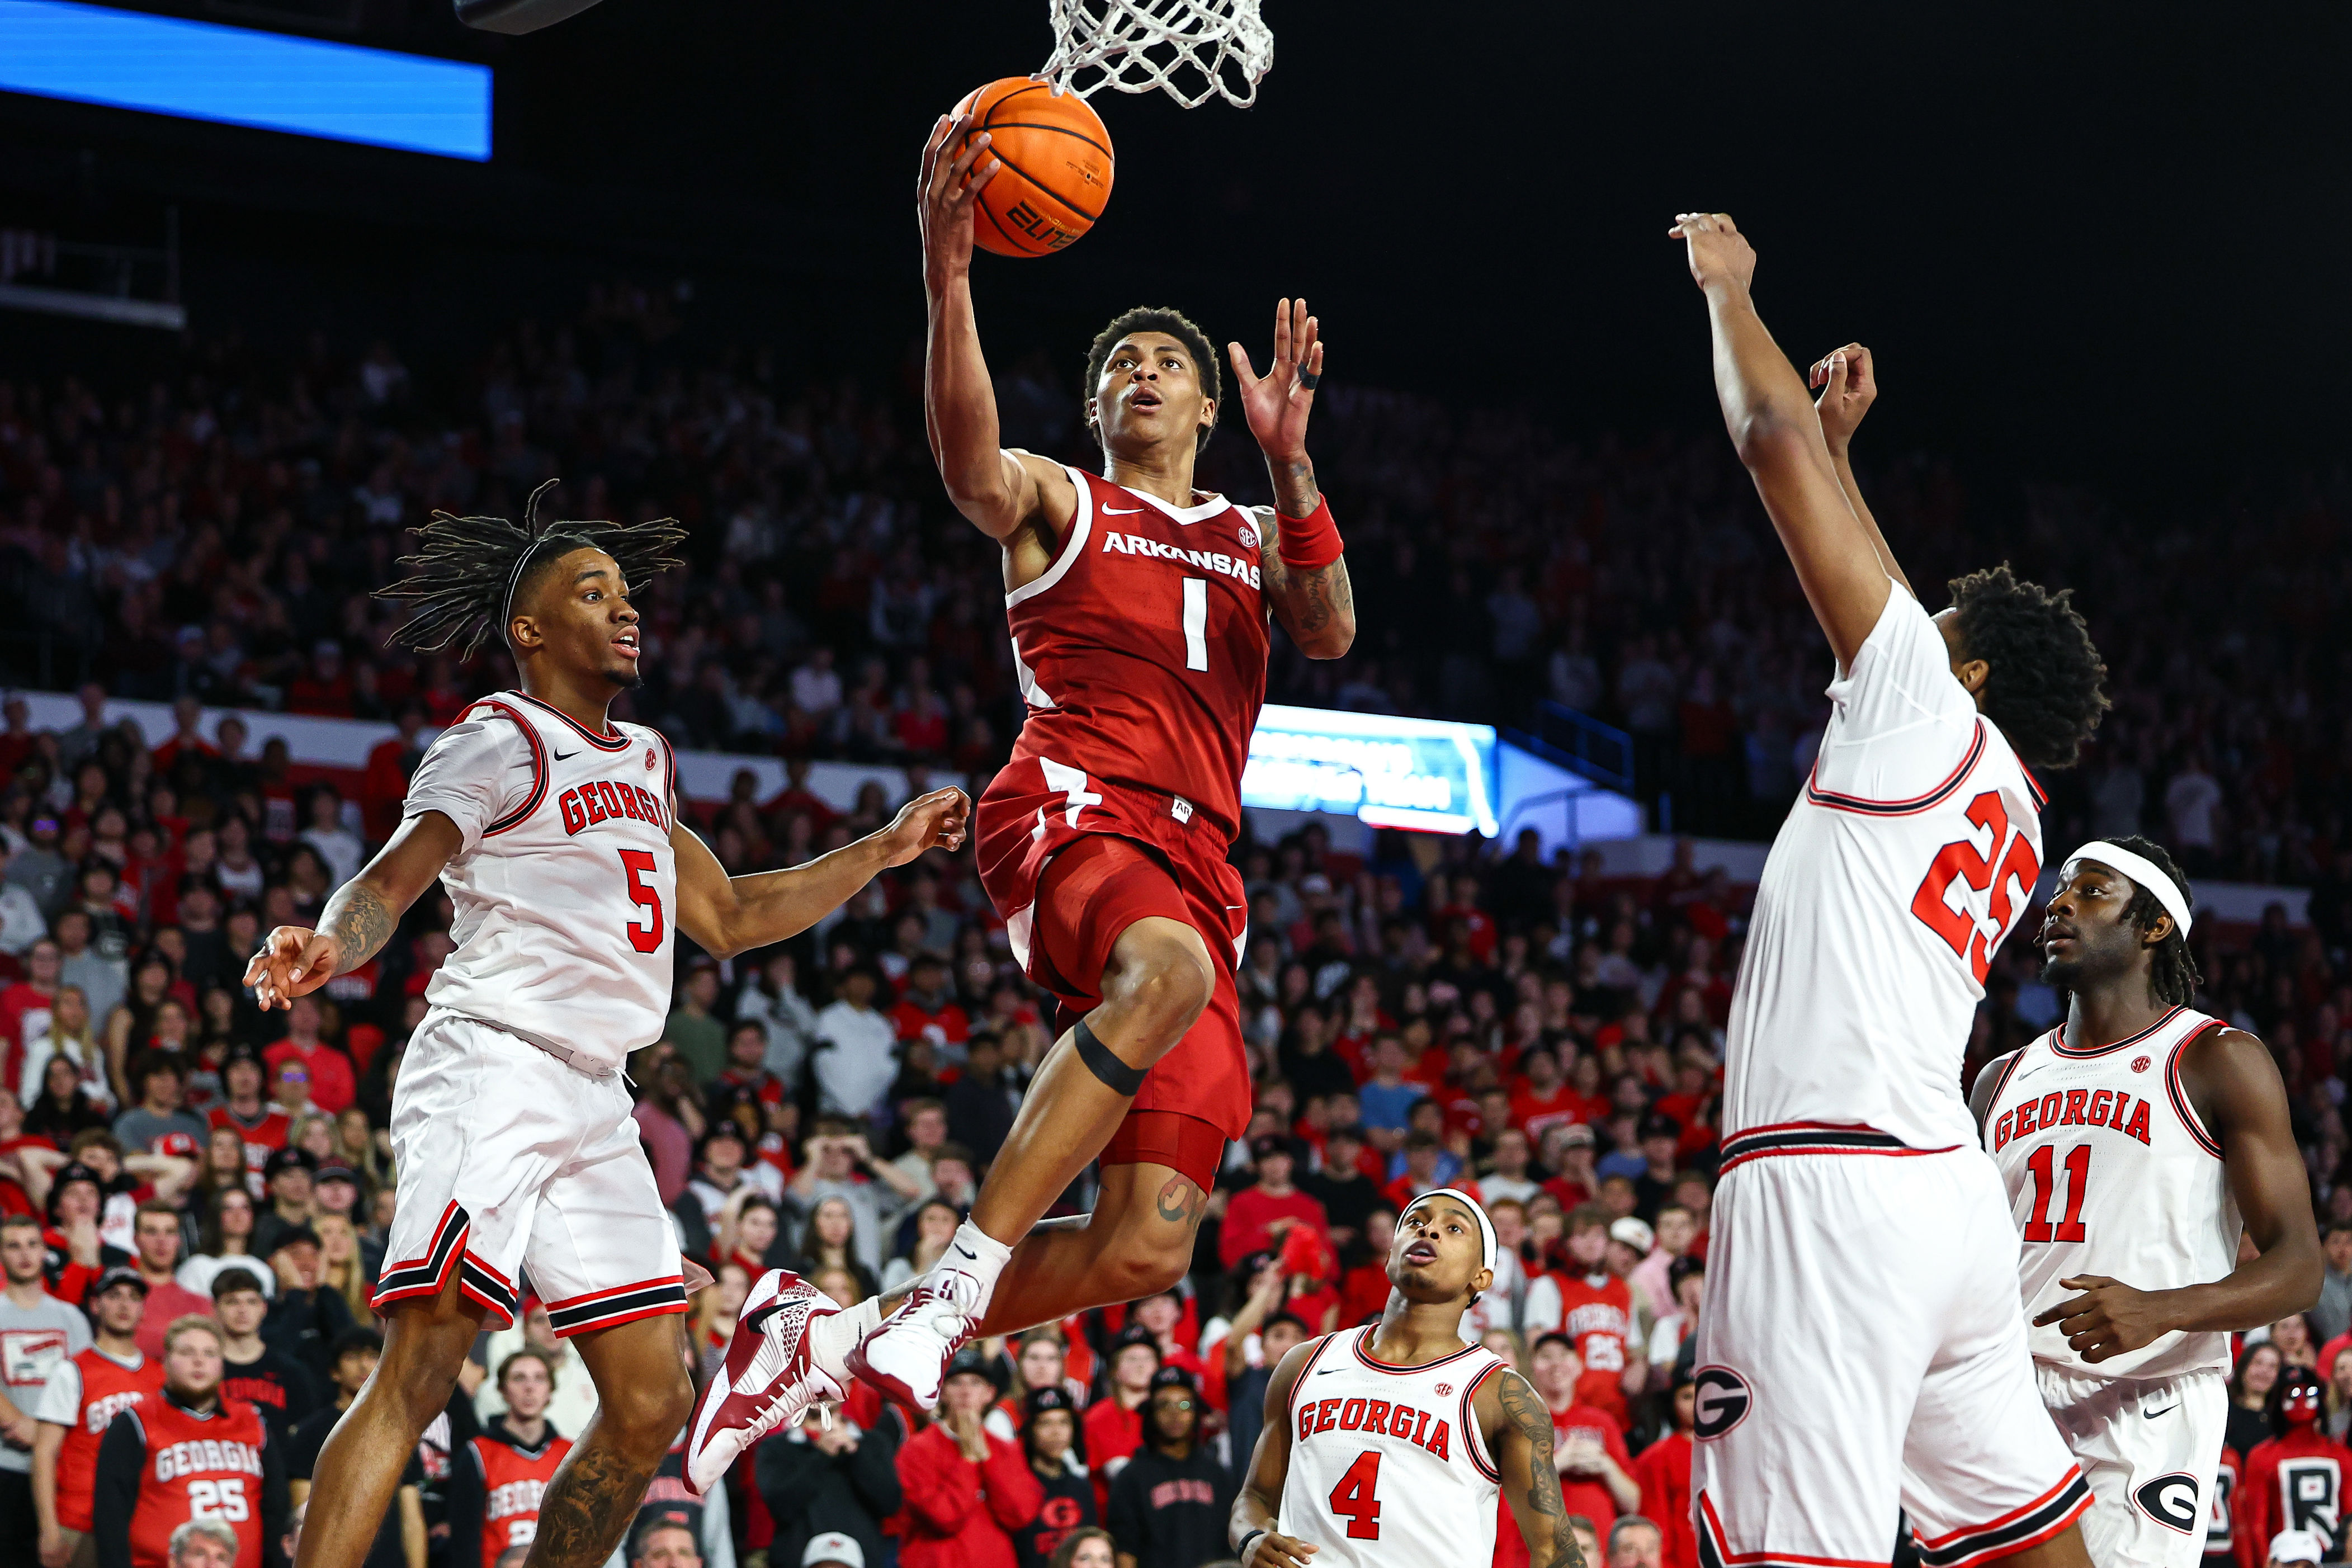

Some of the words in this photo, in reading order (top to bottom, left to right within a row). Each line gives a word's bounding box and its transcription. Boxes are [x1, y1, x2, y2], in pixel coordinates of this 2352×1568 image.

[1006, 200, 1077, 248] ELITE
[1102, 531, 1261, 591] ARKANSAS
[1240, 528, 1255, 546] SEC
[1183, 577, 1208, 672] 1
[1175, 802, 1189, 817] AR
[617, 848, 664, 954] 5
[1910, 789, 2041, 987] 25
[2132, 1057, 2150, 1071] SEC
[1995, 1089, 2151, 1154] GEORGIA
[2023, 1144, 2091, 1243] 11
[1436, 1382, 1452, 1395] SEC
[1694, 1367, 1750, 1439] G
[155, 1438, 265, 1482] GEORGIA
[1298, 1397, 1450, 1463] GEORGIA
[187, 1477, 249, 1522] 25
[1329, 1450, 1382, 1541] 4
[2136, 1474, 2199, 1532] G
[2280, 1460, 2340, 1550] R
